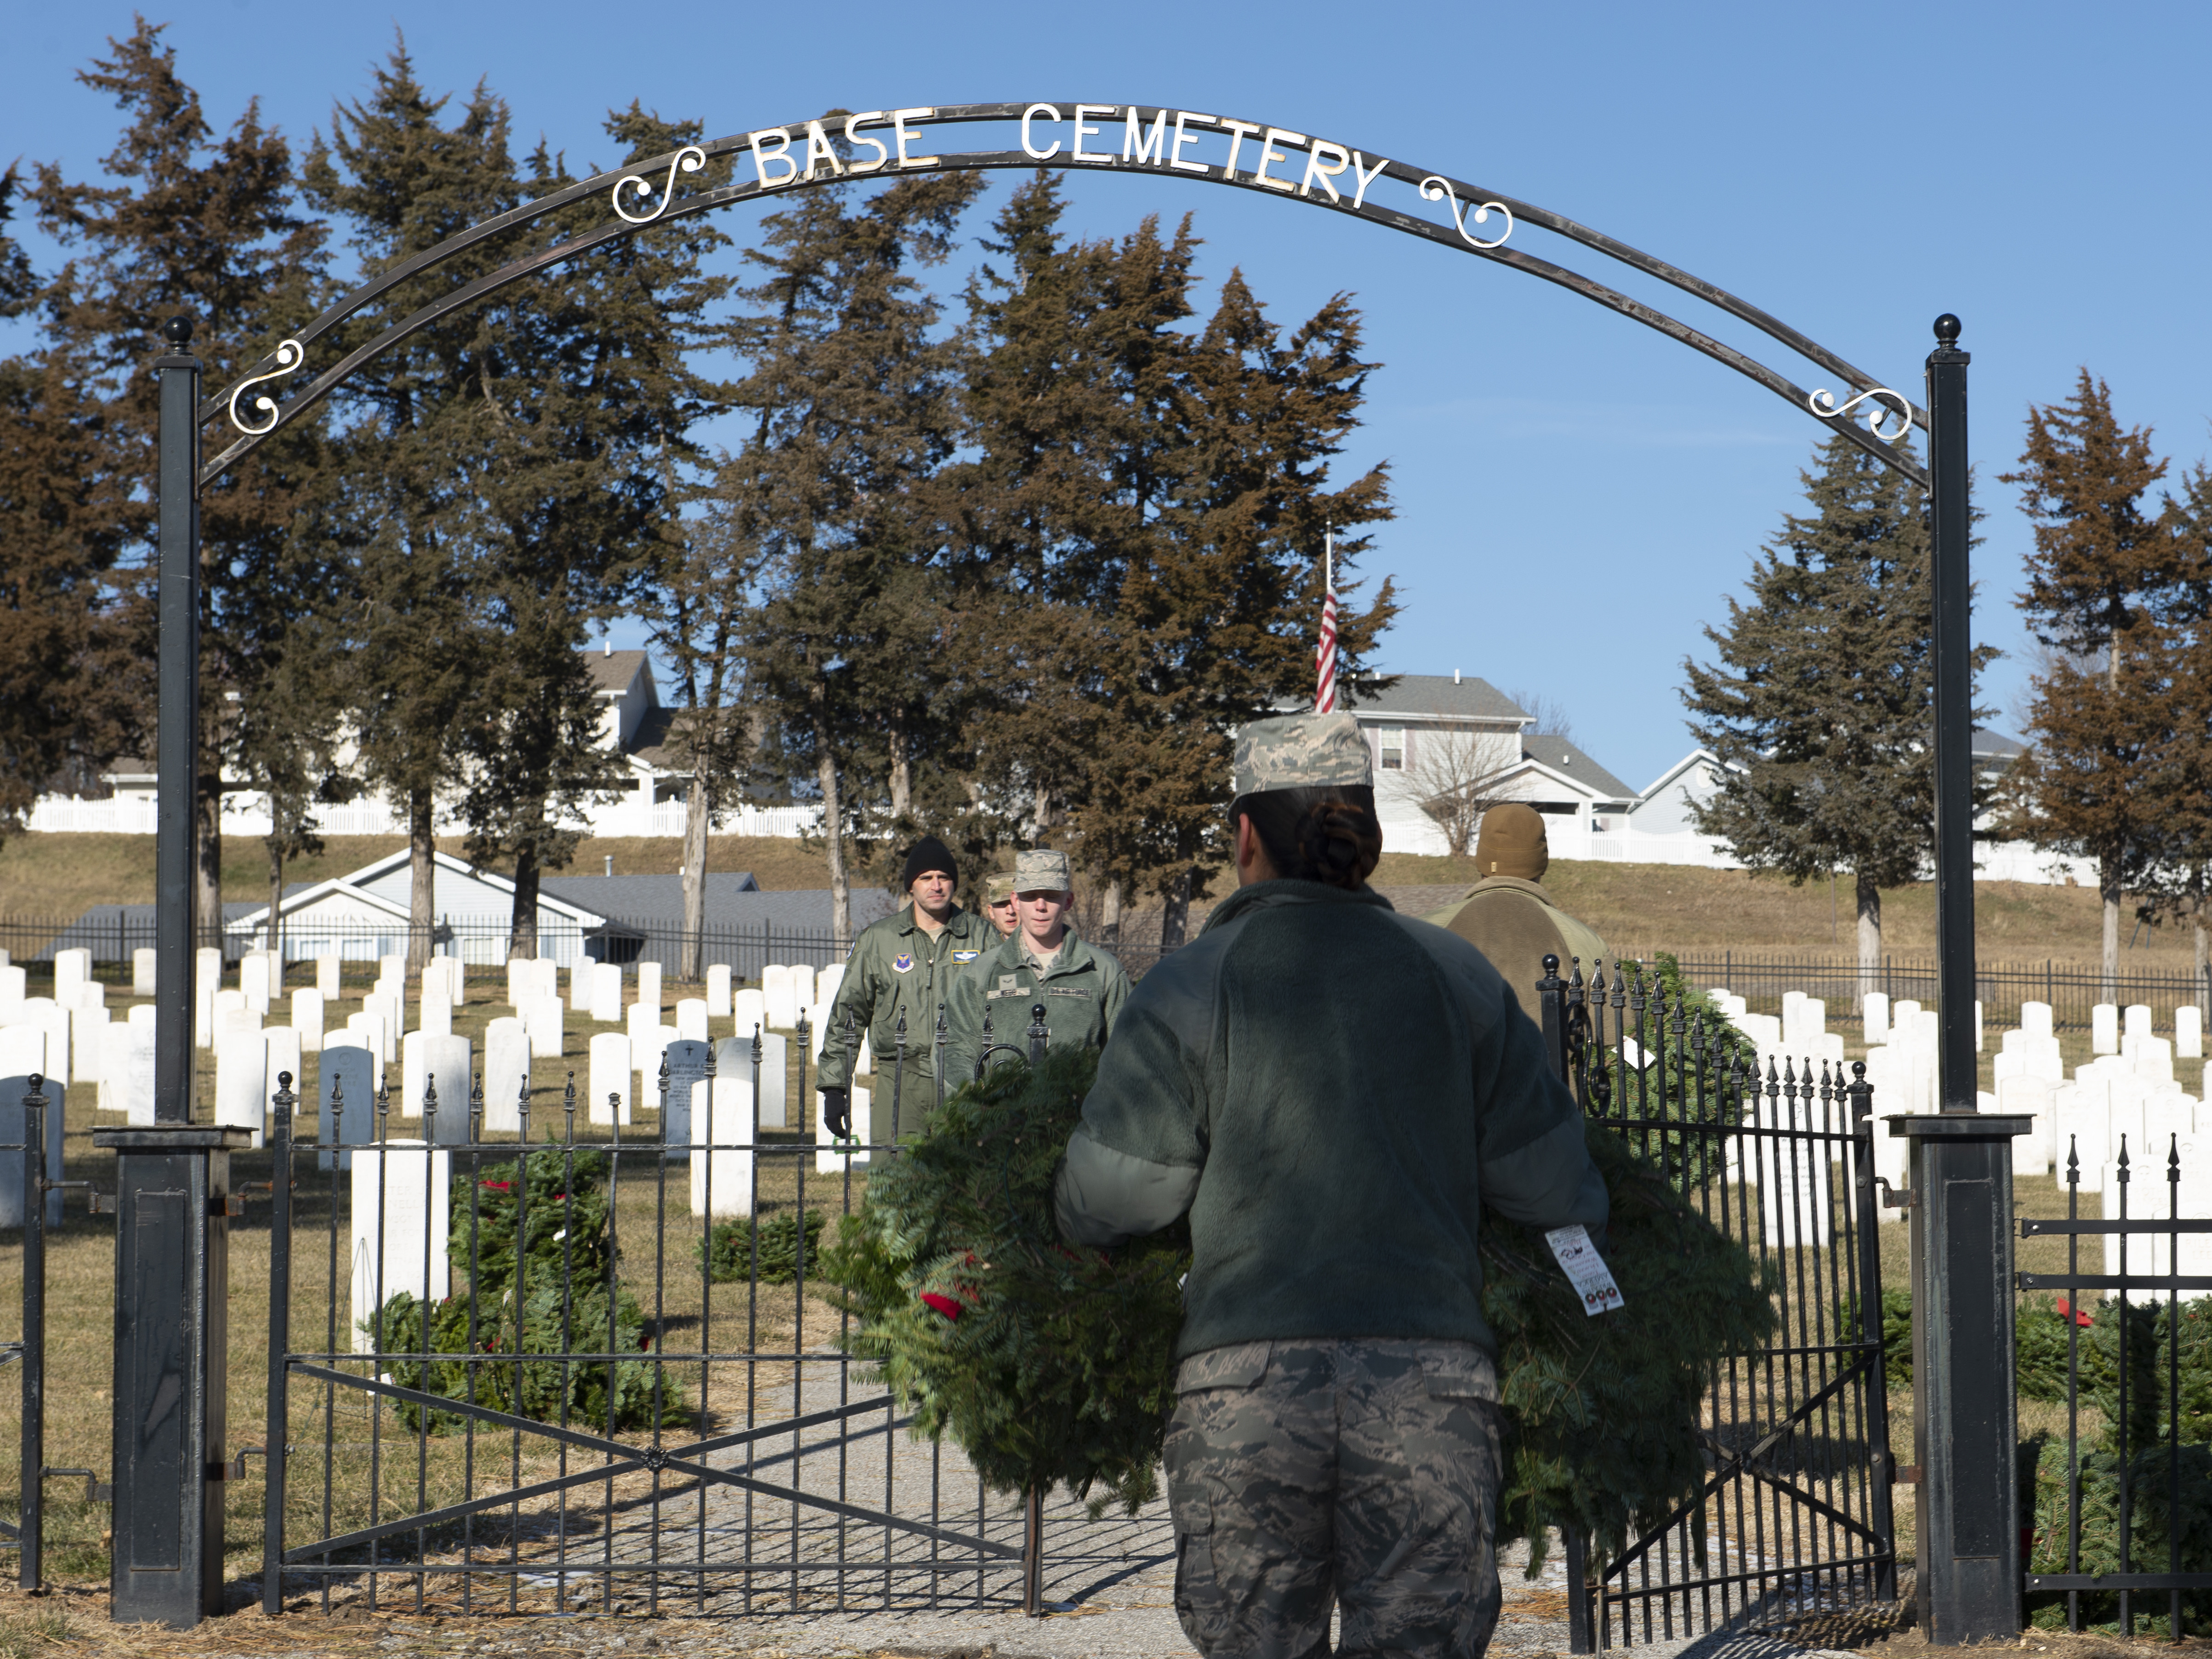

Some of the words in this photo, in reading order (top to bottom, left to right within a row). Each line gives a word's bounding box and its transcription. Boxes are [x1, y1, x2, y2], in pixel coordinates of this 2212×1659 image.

[749, 107, 939, 189] BASE
[1021, 103, 1390, 210] CEMETERY
[375, 1186, 412, 1195] PTER
